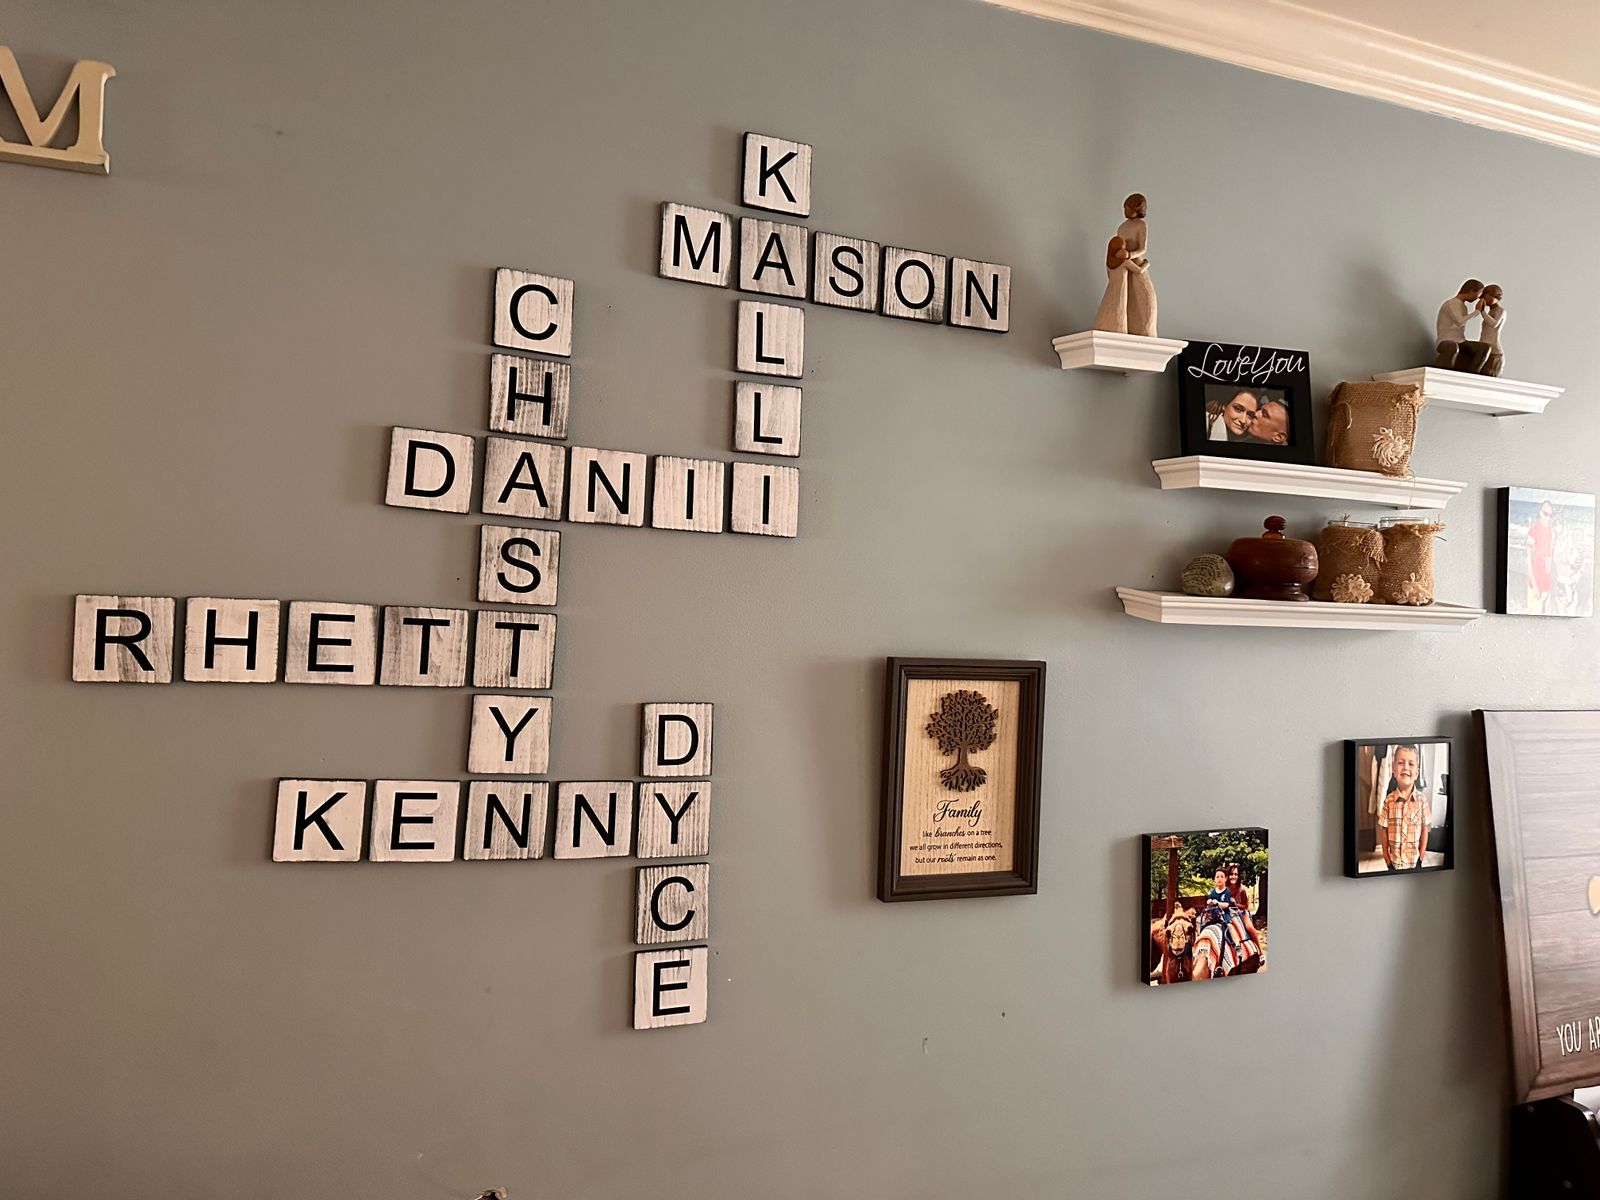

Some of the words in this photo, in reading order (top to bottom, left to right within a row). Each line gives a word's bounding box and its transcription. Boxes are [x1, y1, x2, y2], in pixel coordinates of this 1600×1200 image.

[671, 213, 1001, 323] MASON
[752, 144, 799, 527] KALLI
[1187, 343, 1253, 382] Love
[1250, 346, 1305, 384] You
[403, 440, 772, 526] DANII
[484, 284, 559, 850] CHASTYN
[92, 607, 541, 679] RHETT
[291, 790, 699, 852] KENNY
[933, 799, 982, 827] Family
[934, 826, 966, 838] branches
[650, 714, 700, 1018] DYCE
[937, 853, 956, 863] roots
[1556, 1020, 1582, 1056] YOU
